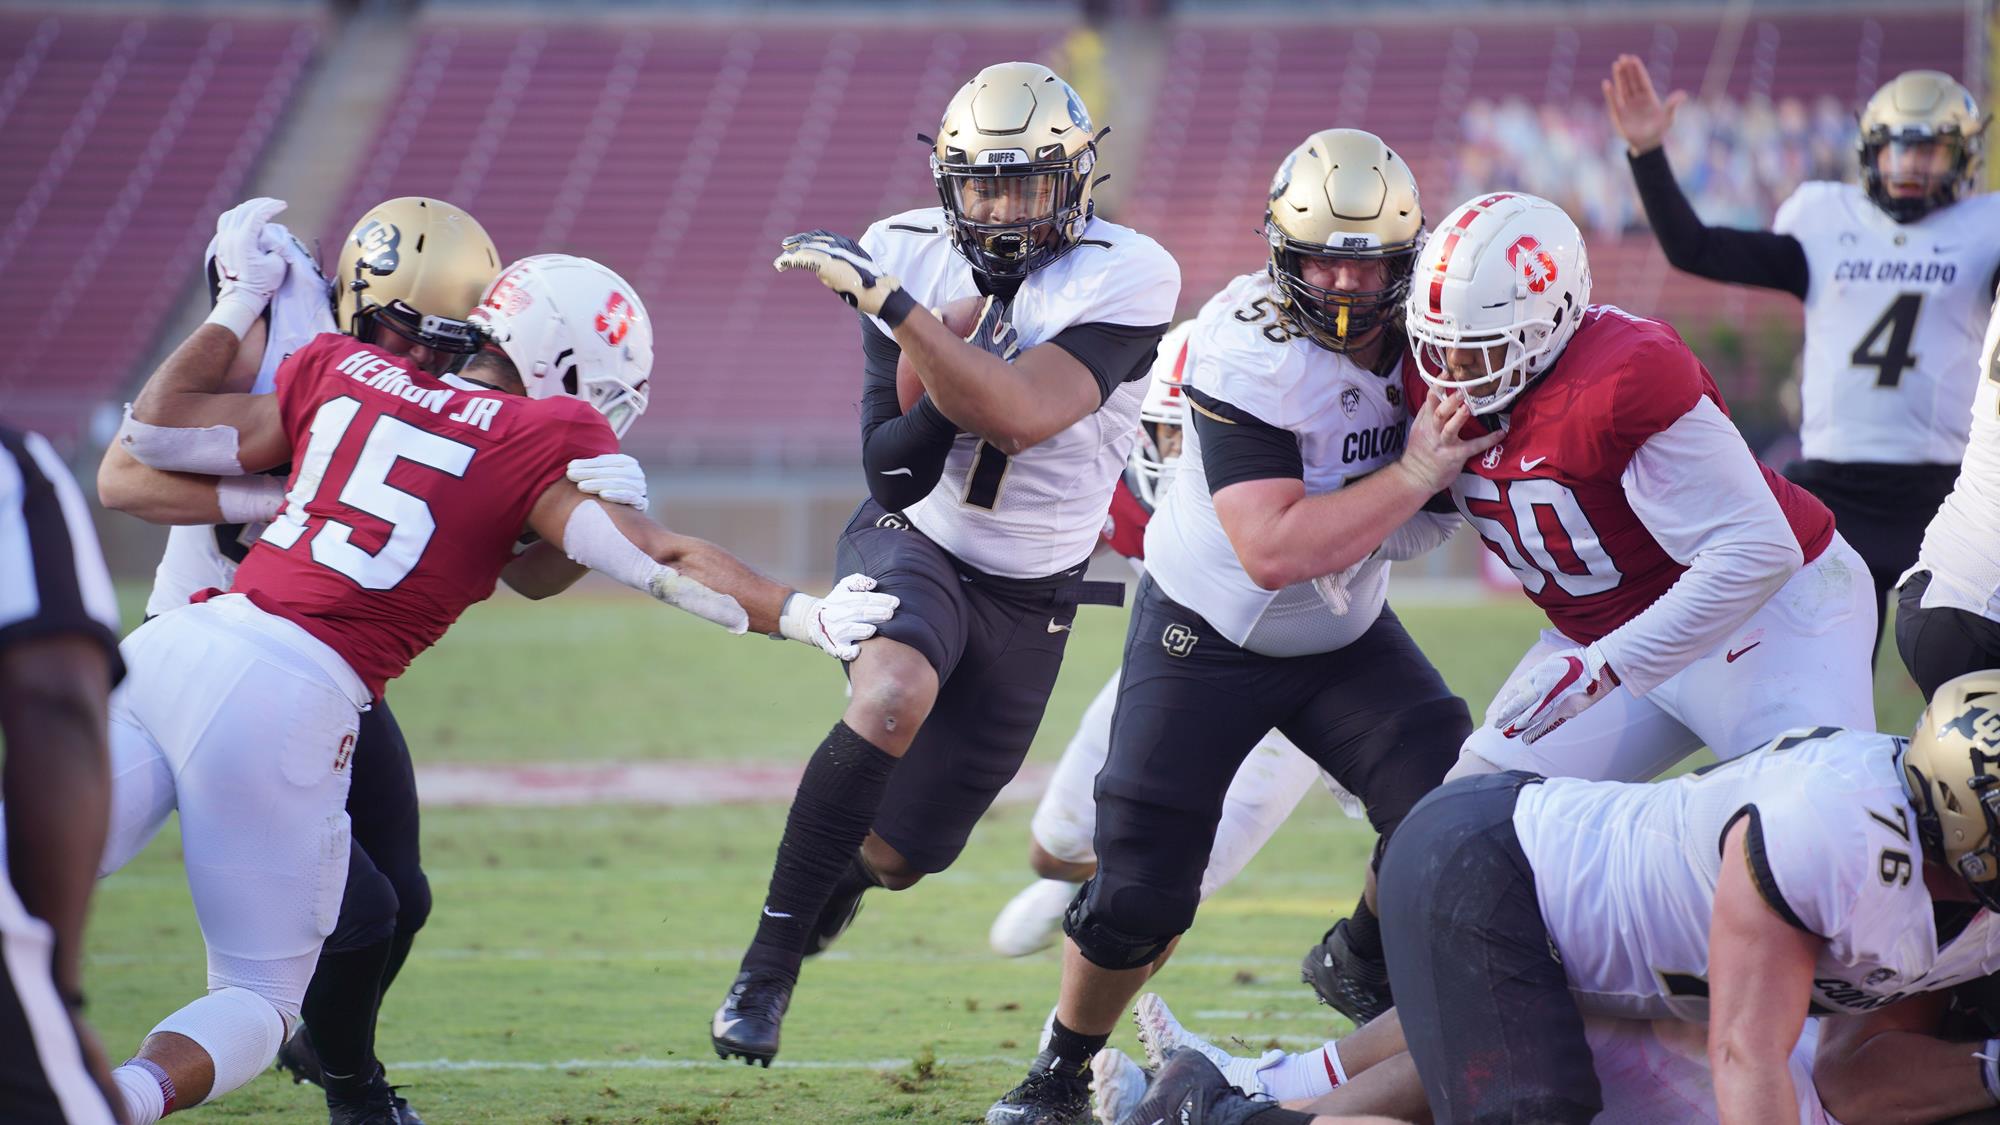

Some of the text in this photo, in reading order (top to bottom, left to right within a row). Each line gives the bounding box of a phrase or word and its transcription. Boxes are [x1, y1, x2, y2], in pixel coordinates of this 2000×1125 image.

[987, 152, 1016, 164] BUFFS
[1000, 234, 1021, 242] SHOCK
[1834, 260, 1958, 284] COLORADO
[1847, 291, 1925, 389] 4
[448, 396, 504, 432] JR
[258, 394, 478, 591] 15
[1449, 473, 1624, 598] 50
[1161, 623, 1199, 658] CU
[1864, 804, 1912, 889] 76
